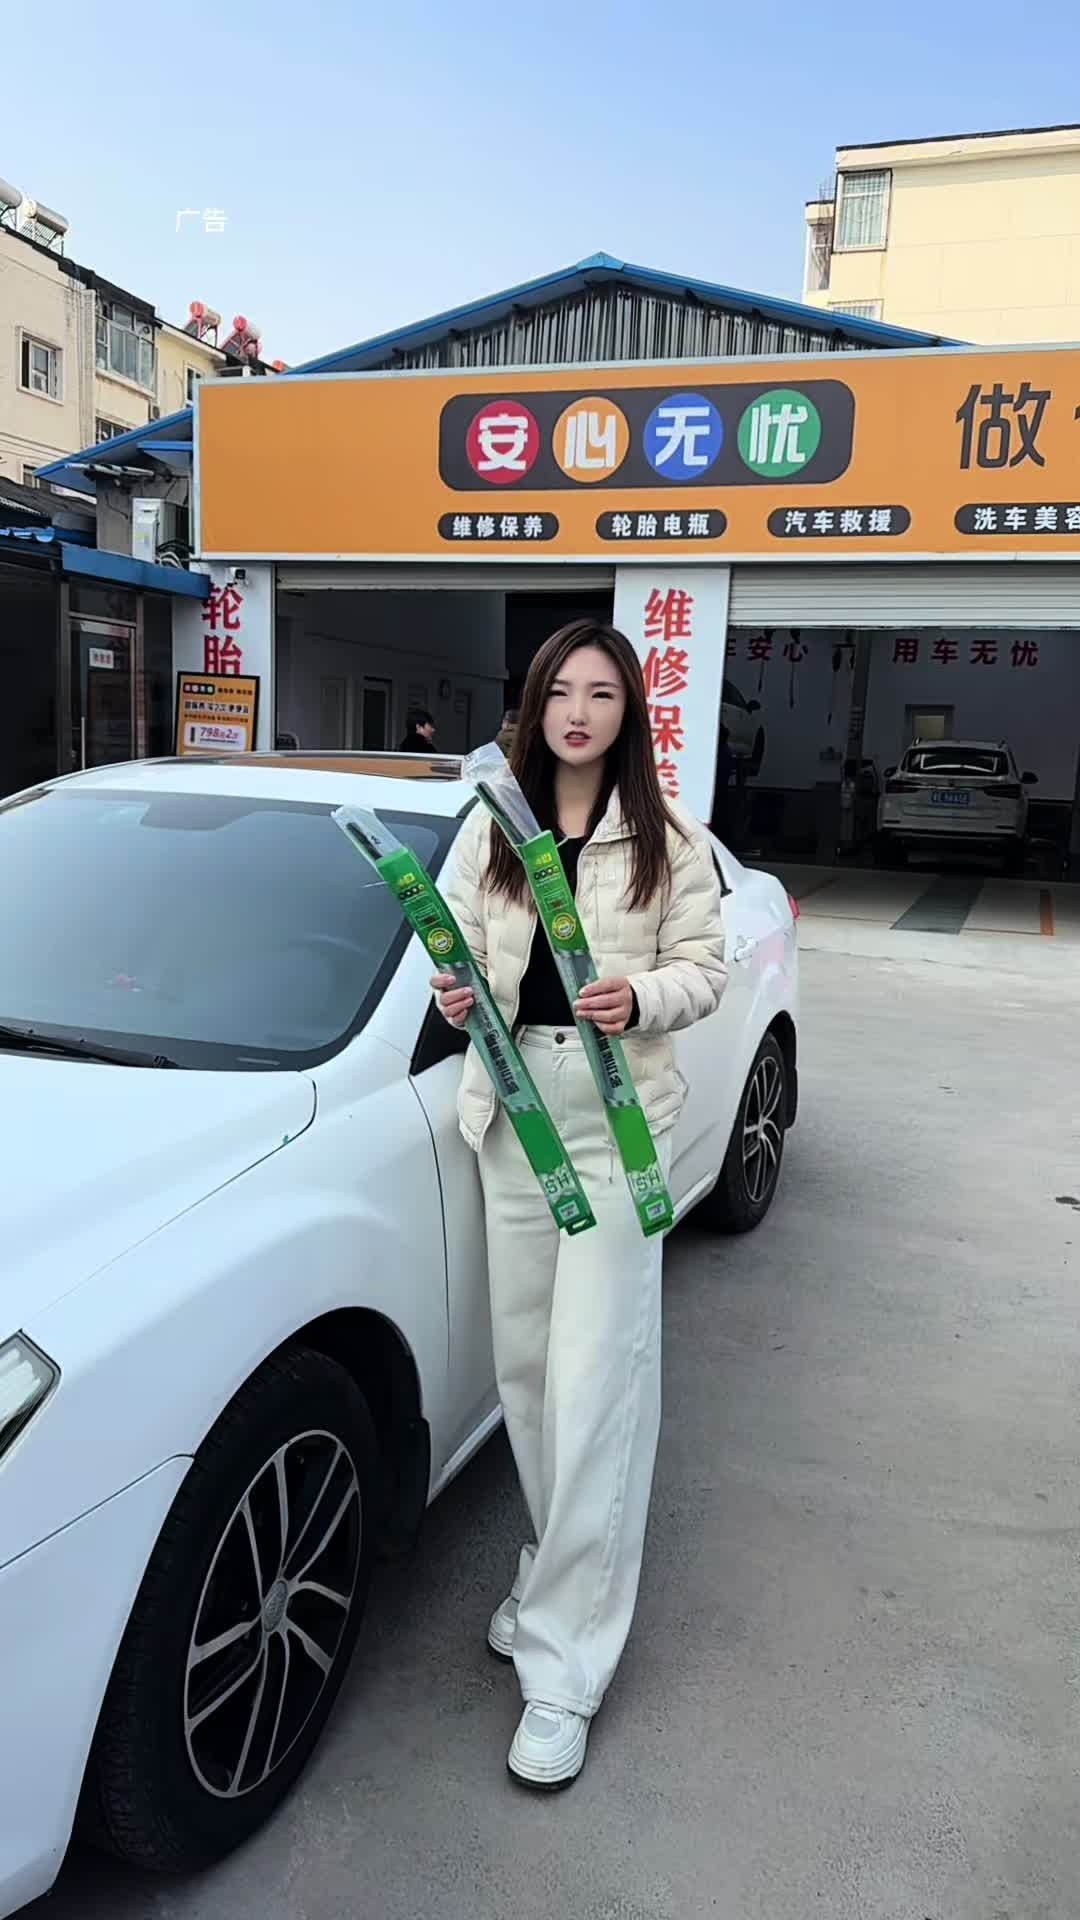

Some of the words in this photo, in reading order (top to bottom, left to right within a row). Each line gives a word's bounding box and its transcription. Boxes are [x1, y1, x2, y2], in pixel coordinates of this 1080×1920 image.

[477, 403, 807, 472] 安心无忧
[955, 382, 1080, 470] 做
[452, 515, 544, 538] 维修保养
[611, 509, 710, 537] 轮胎电瓶
[785, 509, 891, 533] 汽车救援
[974, 506, 1080, 530] 洗车美容
[201, 582, 244, 674] 轮胎
[893, 638, 1039, 667] 用车无忧
